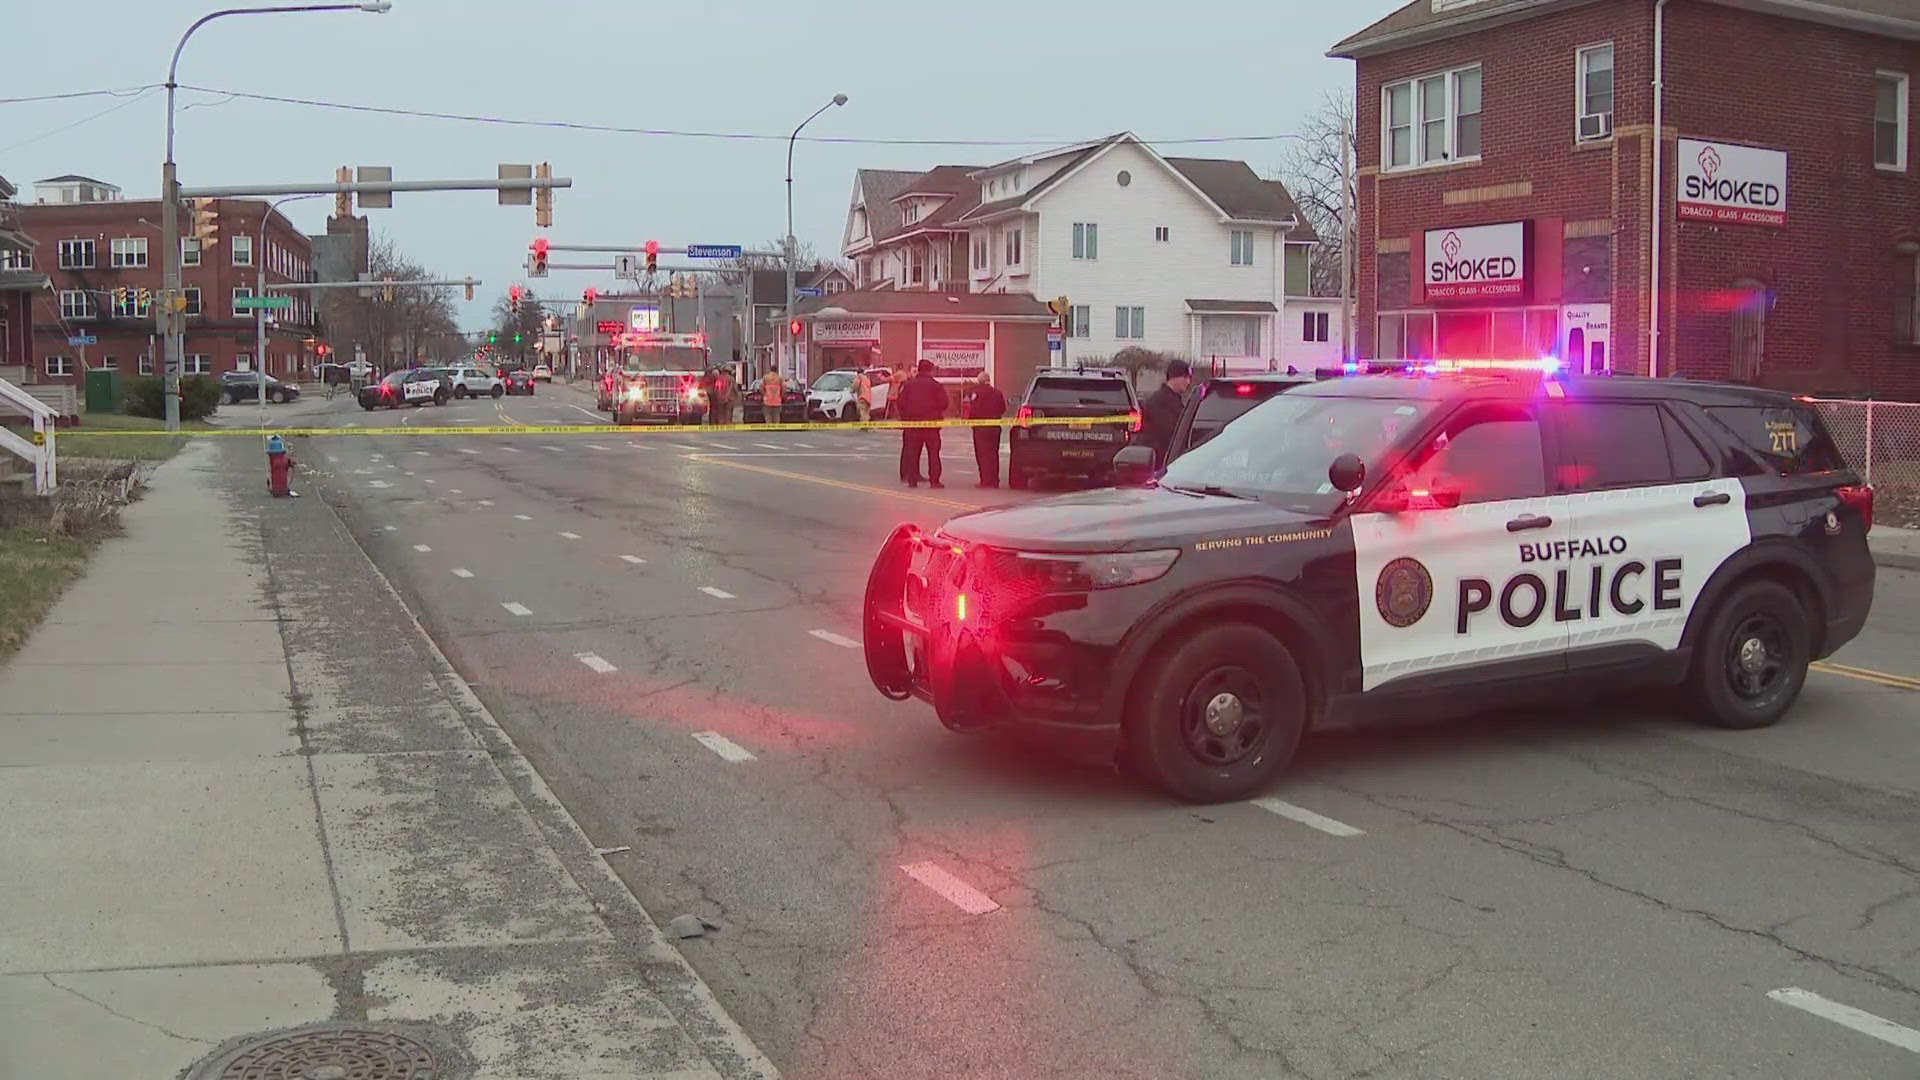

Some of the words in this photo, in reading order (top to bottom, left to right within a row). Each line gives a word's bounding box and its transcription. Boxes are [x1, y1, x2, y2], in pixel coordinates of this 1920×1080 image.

[1685, 175, 1779, 206] SMOKED
[1681, 206, 1713, 216] TOBACCO
[1717, 209, 1738, 220] GLASS
[1742, 212, 1783, 224] ACCESSORIES
[688, 246, 732, 258] Stevenson
[1431, 257, 1516, 281] SMOKED
[1428, 288, 1455, 296] TOBACCO
[1458, 286, 1477, 295] GLASS
[1480, 283, 1521, 294] ACCESSORIES
[935, 352, 980, 360] WILLOUGHBY
[1769, 431, 1797, 451] 277
[1195, 538, 1242, 551] SERVING
[1245, 537, 1265, 545] THE
[1267, 529, 1332, 544] COMMUNITY
[1519, 535, 1627, 563] BUFFALO
[1456, 556, 1683, 635] POLICE
